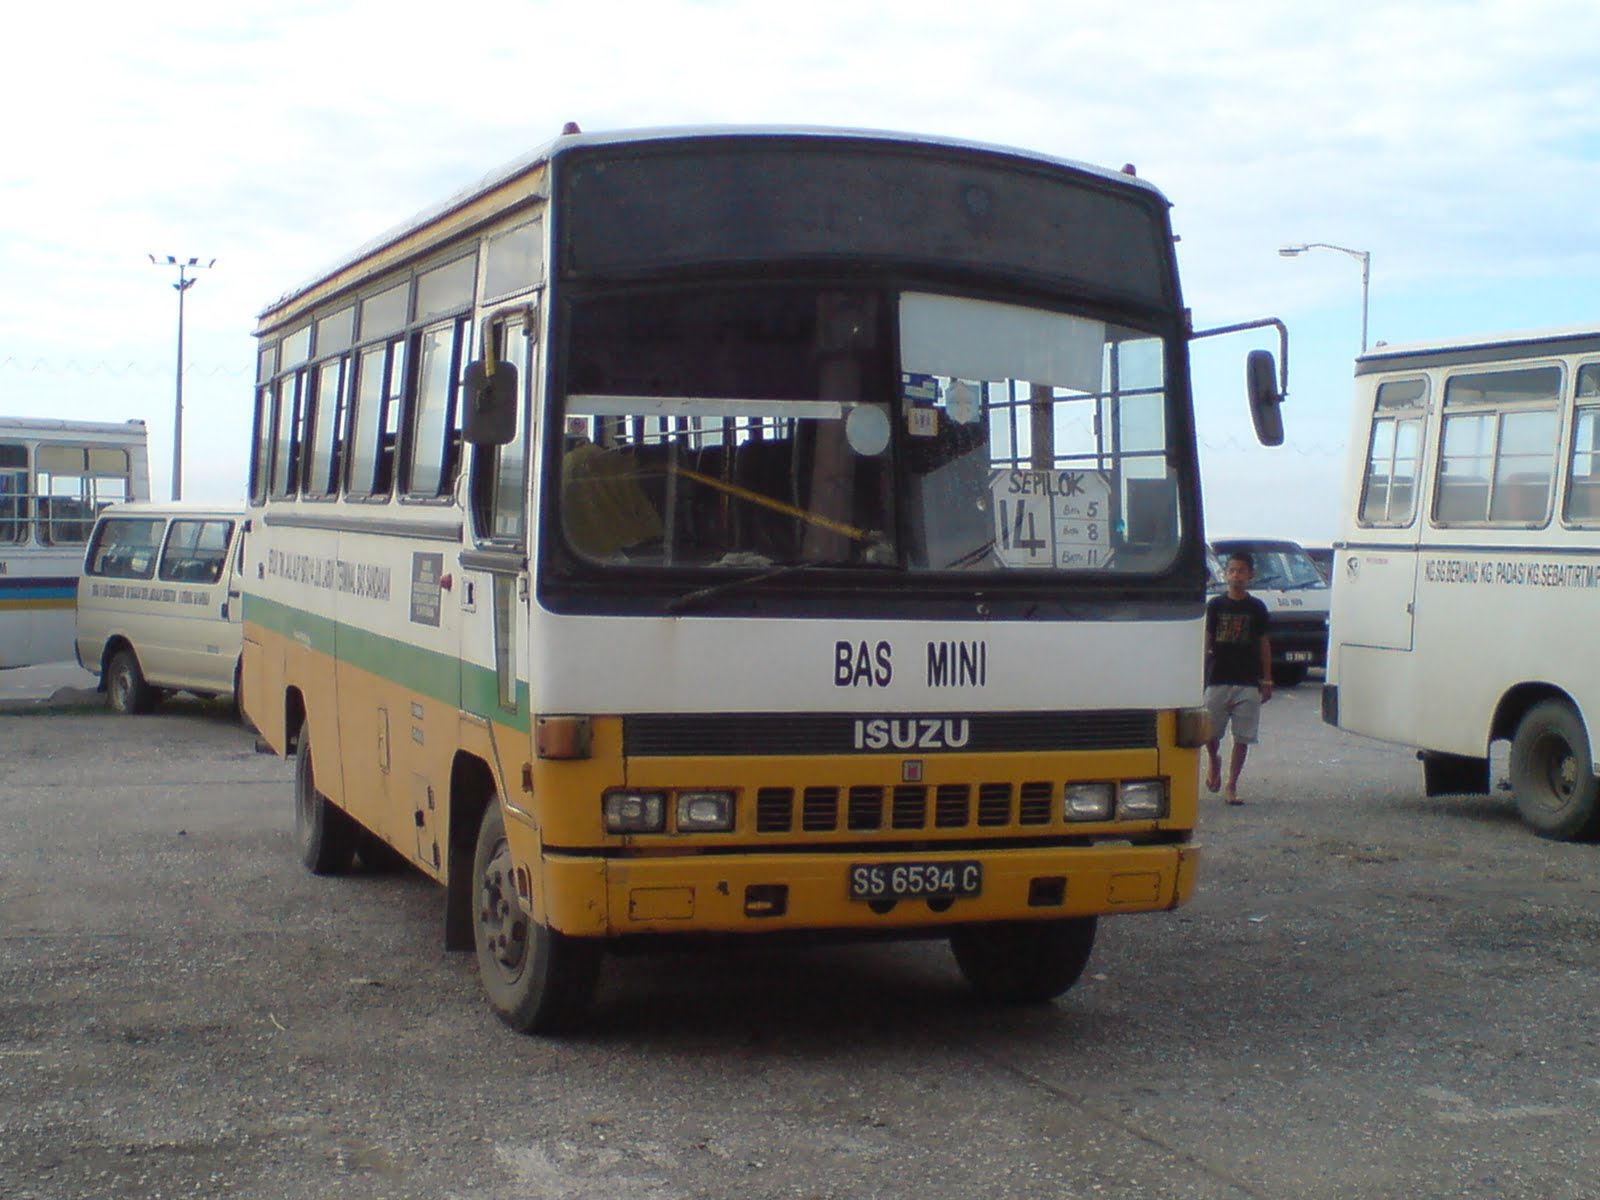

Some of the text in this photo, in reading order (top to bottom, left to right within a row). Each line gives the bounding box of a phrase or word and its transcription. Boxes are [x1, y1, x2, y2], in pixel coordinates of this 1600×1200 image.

[1008, 471, 1085, 497] SEPILOK
[1087, 501, 1099, 518] 5
[999, 499, 1046, 557] 14
[1087, 523, 1099, 541] 8
[1087, 549, 1097, 565] 11
[834, 640, 987, 688] BAS MINI
[854, 719, 969, 749] ISUZU
[853, 865, 978, 894] SS 6534 C
